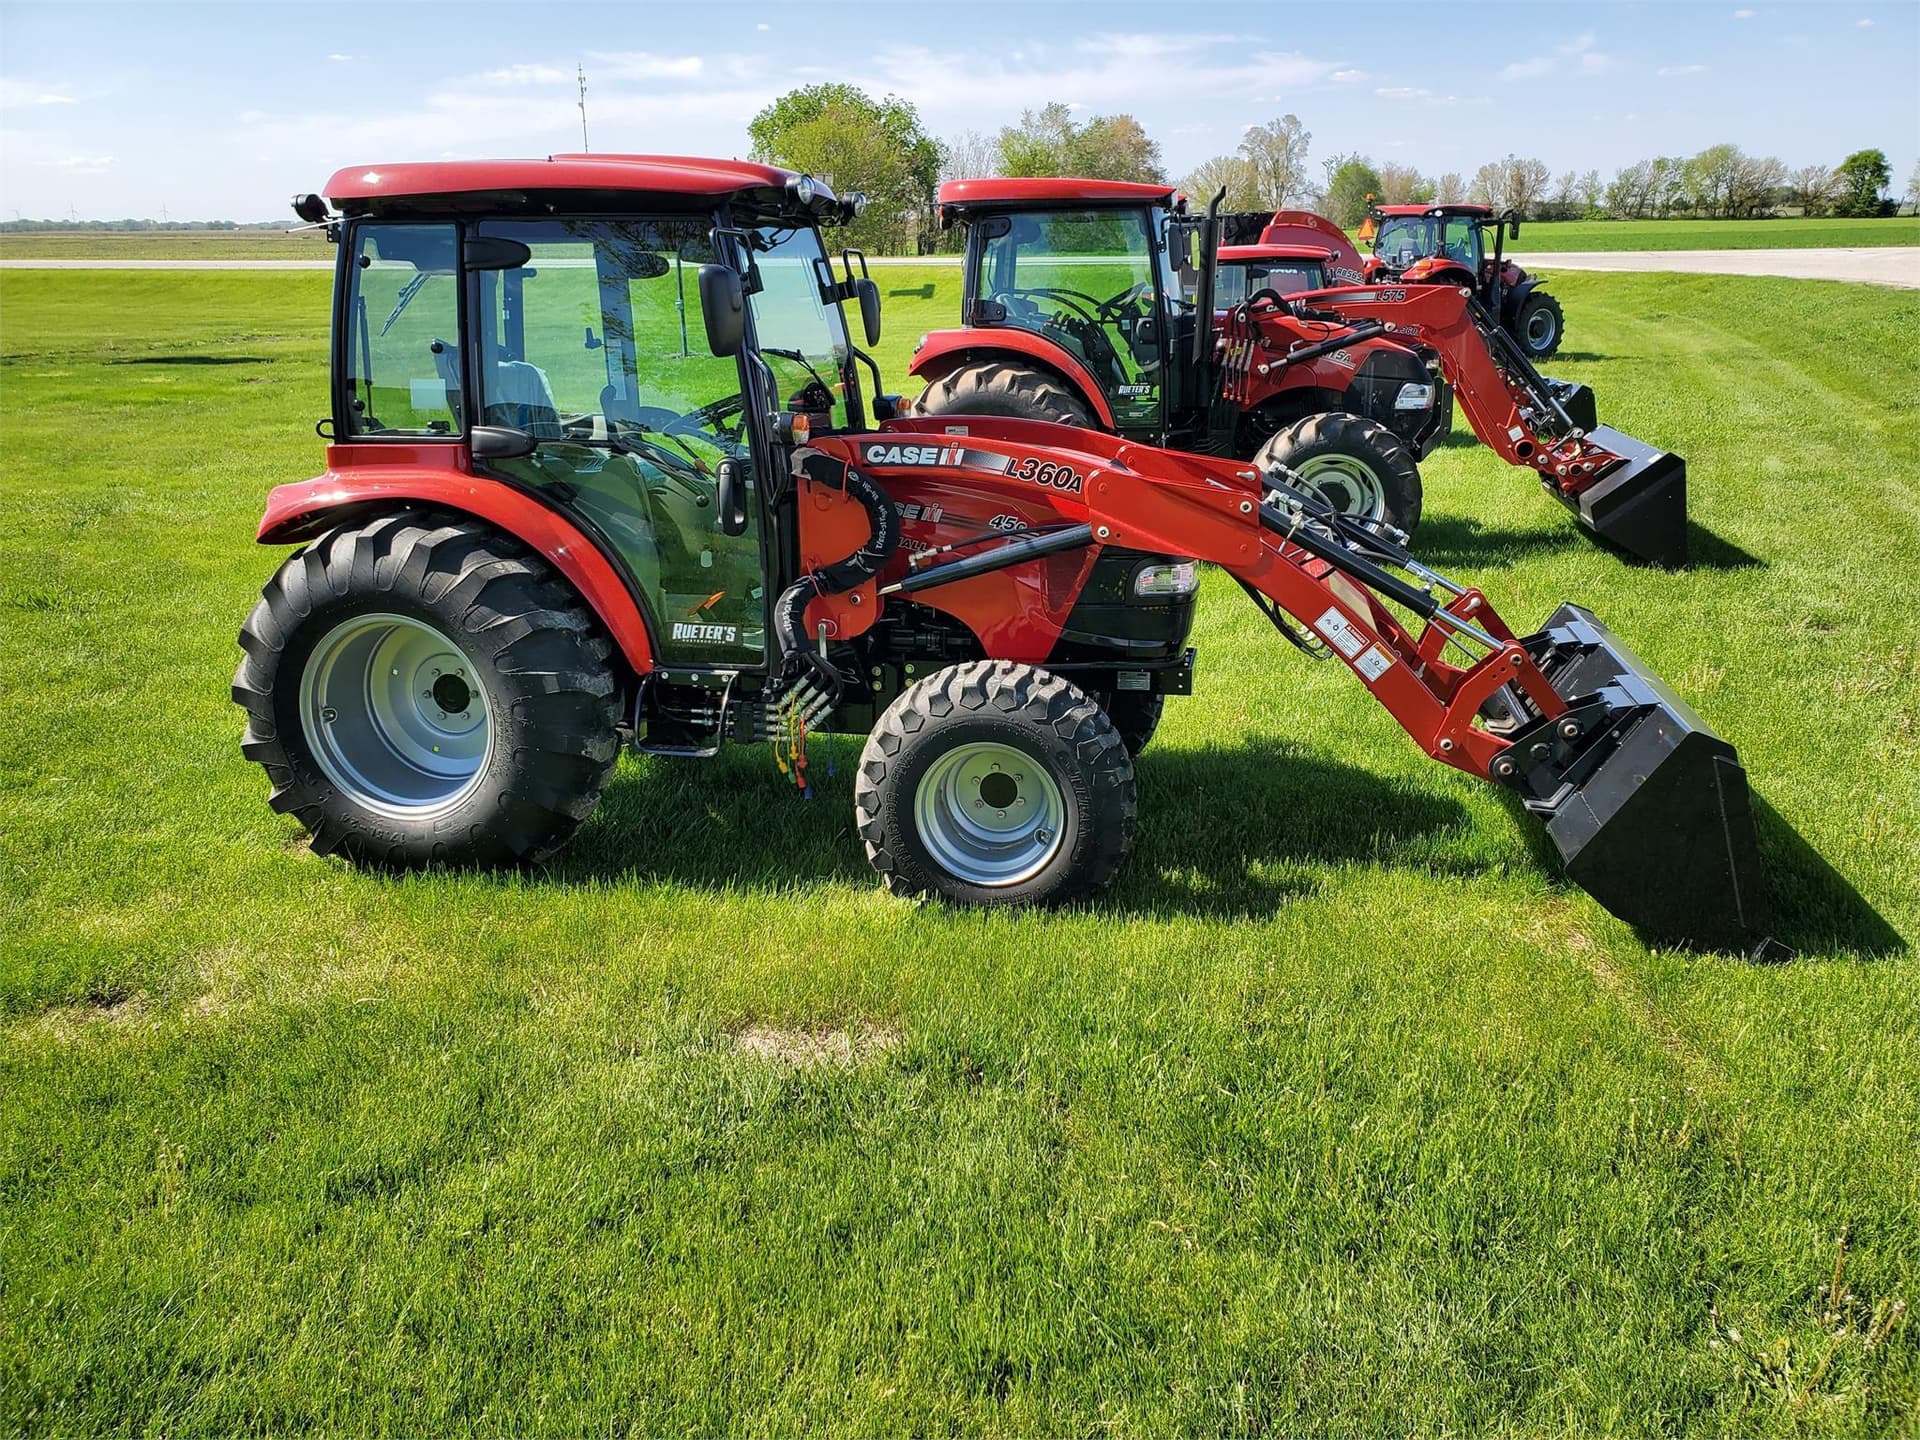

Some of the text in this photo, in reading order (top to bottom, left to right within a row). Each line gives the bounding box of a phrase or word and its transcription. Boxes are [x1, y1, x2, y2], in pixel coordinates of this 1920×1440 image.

[1376, 289, 1406, 302] L575
[866, 445, 938, 465] CASE
[1005, 458, 1084, 494] L360A
[672, 622, 737, 642] RUETER'S
